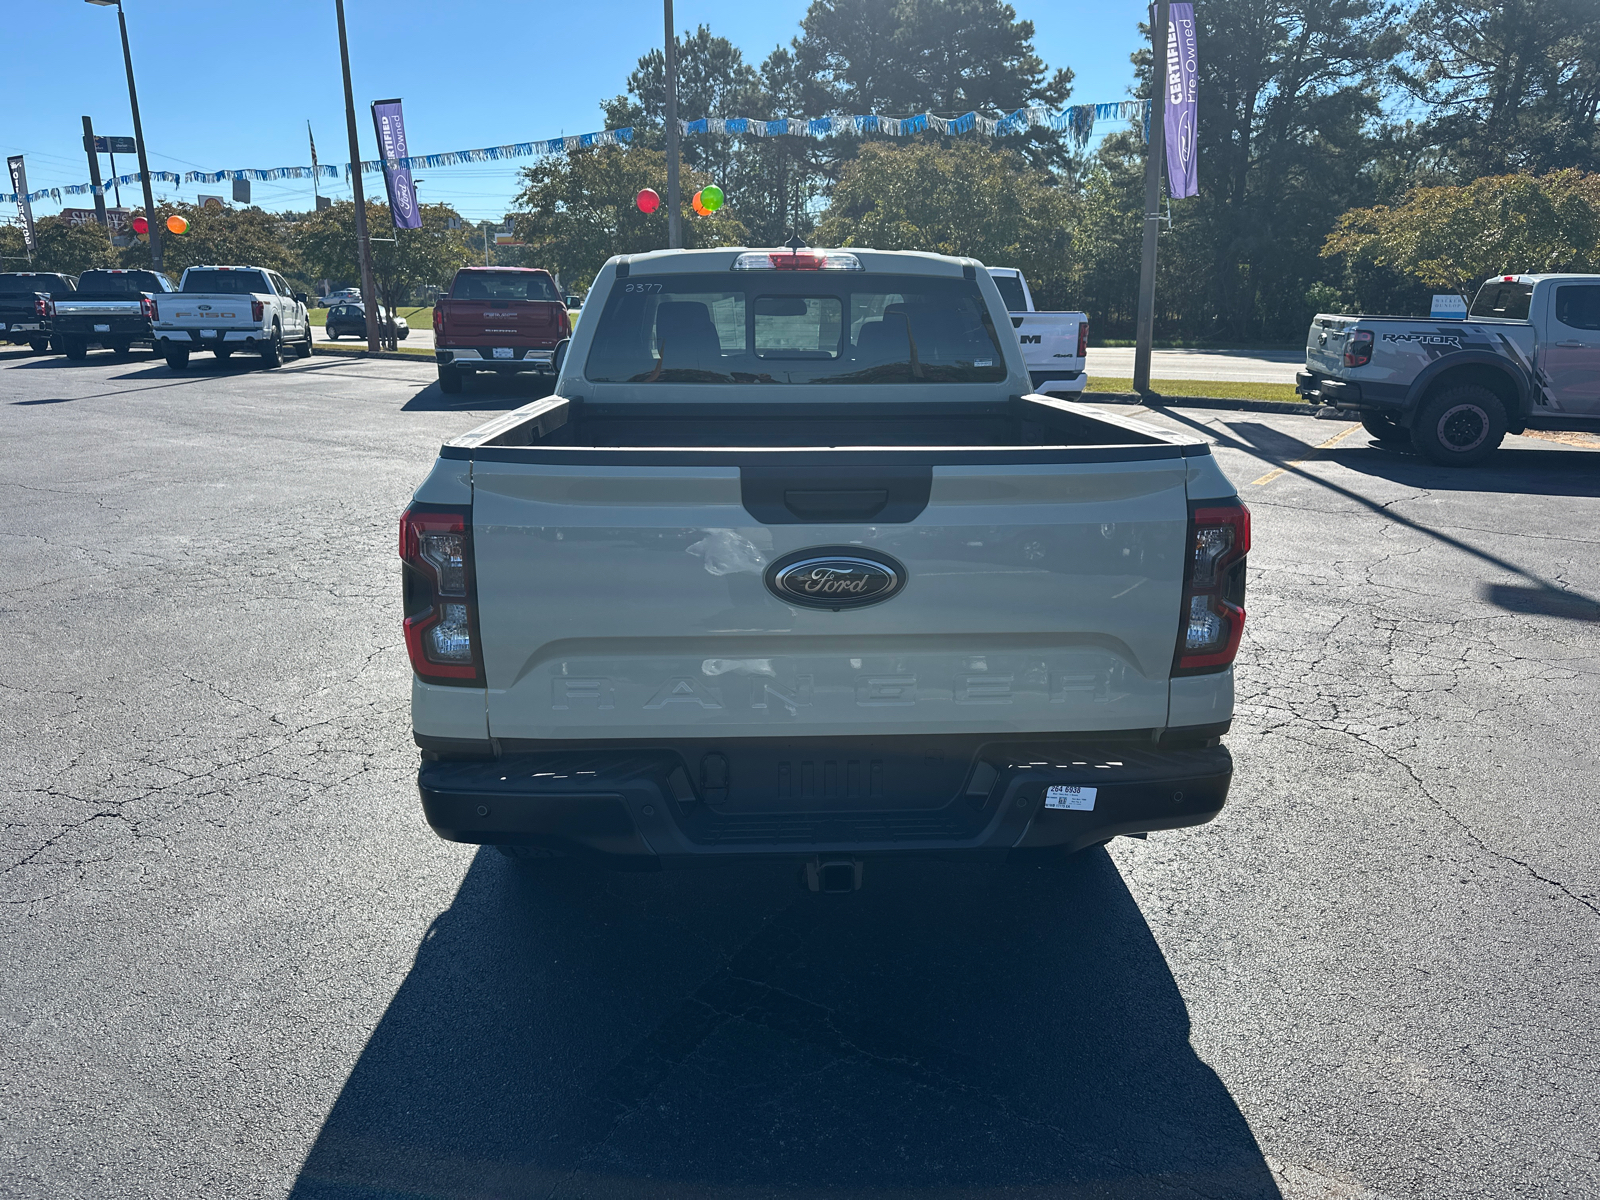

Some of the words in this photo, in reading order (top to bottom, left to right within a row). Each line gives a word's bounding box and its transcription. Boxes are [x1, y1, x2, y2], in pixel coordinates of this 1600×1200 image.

[1166, 21, 1183, 105] CERTIFIED
[625, 283, 663, 293] 2377
[1382, 333, 1463, 350] RAPTOR
[804, 567, 869, 593] Ford
[550, 672, 1112, 710] RANGER
